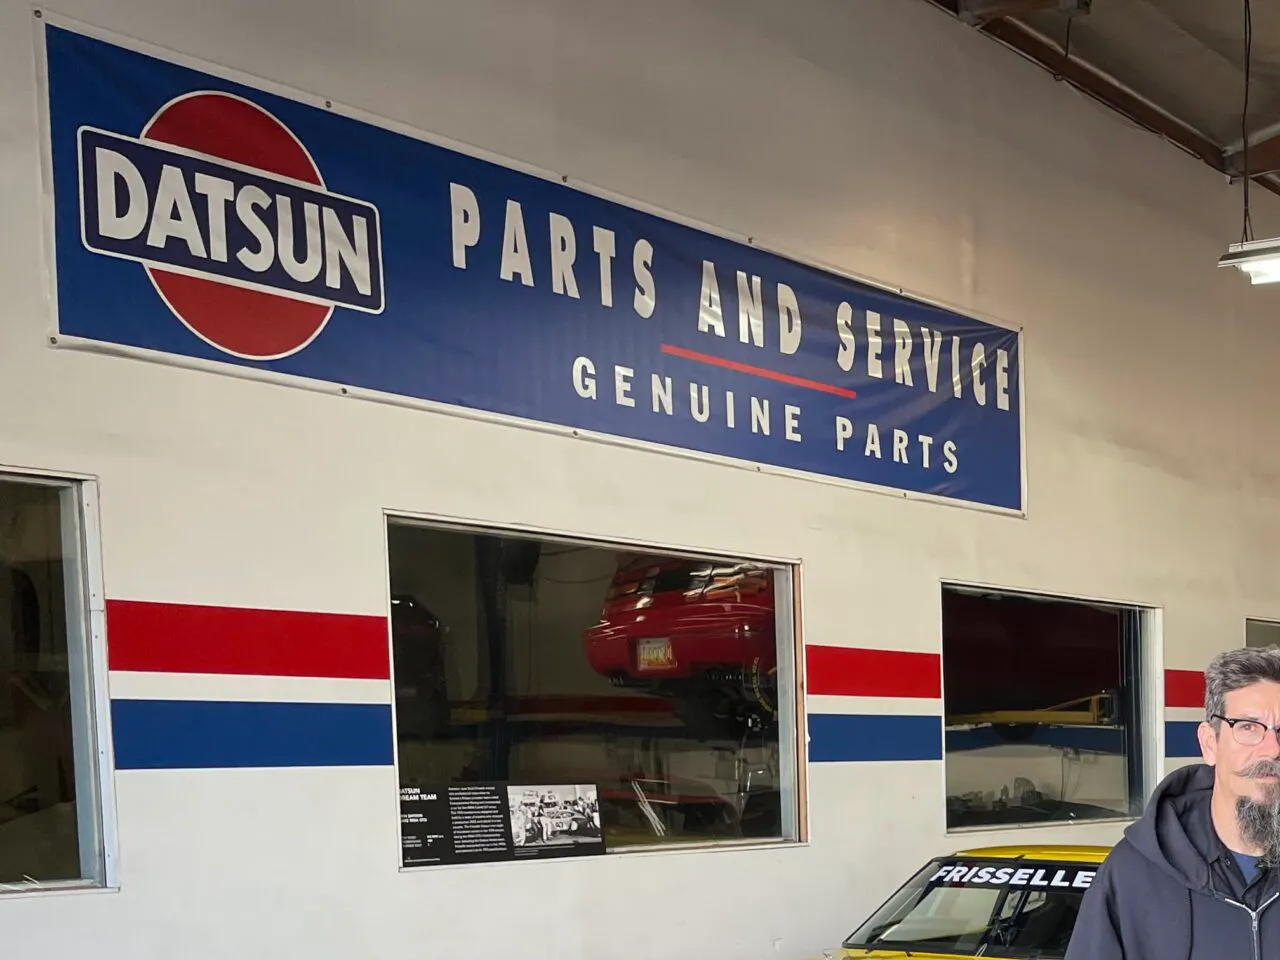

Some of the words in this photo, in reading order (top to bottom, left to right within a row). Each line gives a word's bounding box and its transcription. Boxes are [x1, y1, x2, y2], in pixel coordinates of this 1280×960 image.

[94, 146, 373, 296] DATSUN
[448, 181, 656, 319] PARTS
[696, 259, 803, 355] AND
[836, 300, 1011, 412] SERVICE
[571, 355, 803, 443] GENUINE
[835, 415, 960, 474] PARTS
[929, 866, 1097, 888] FRISSELLE
